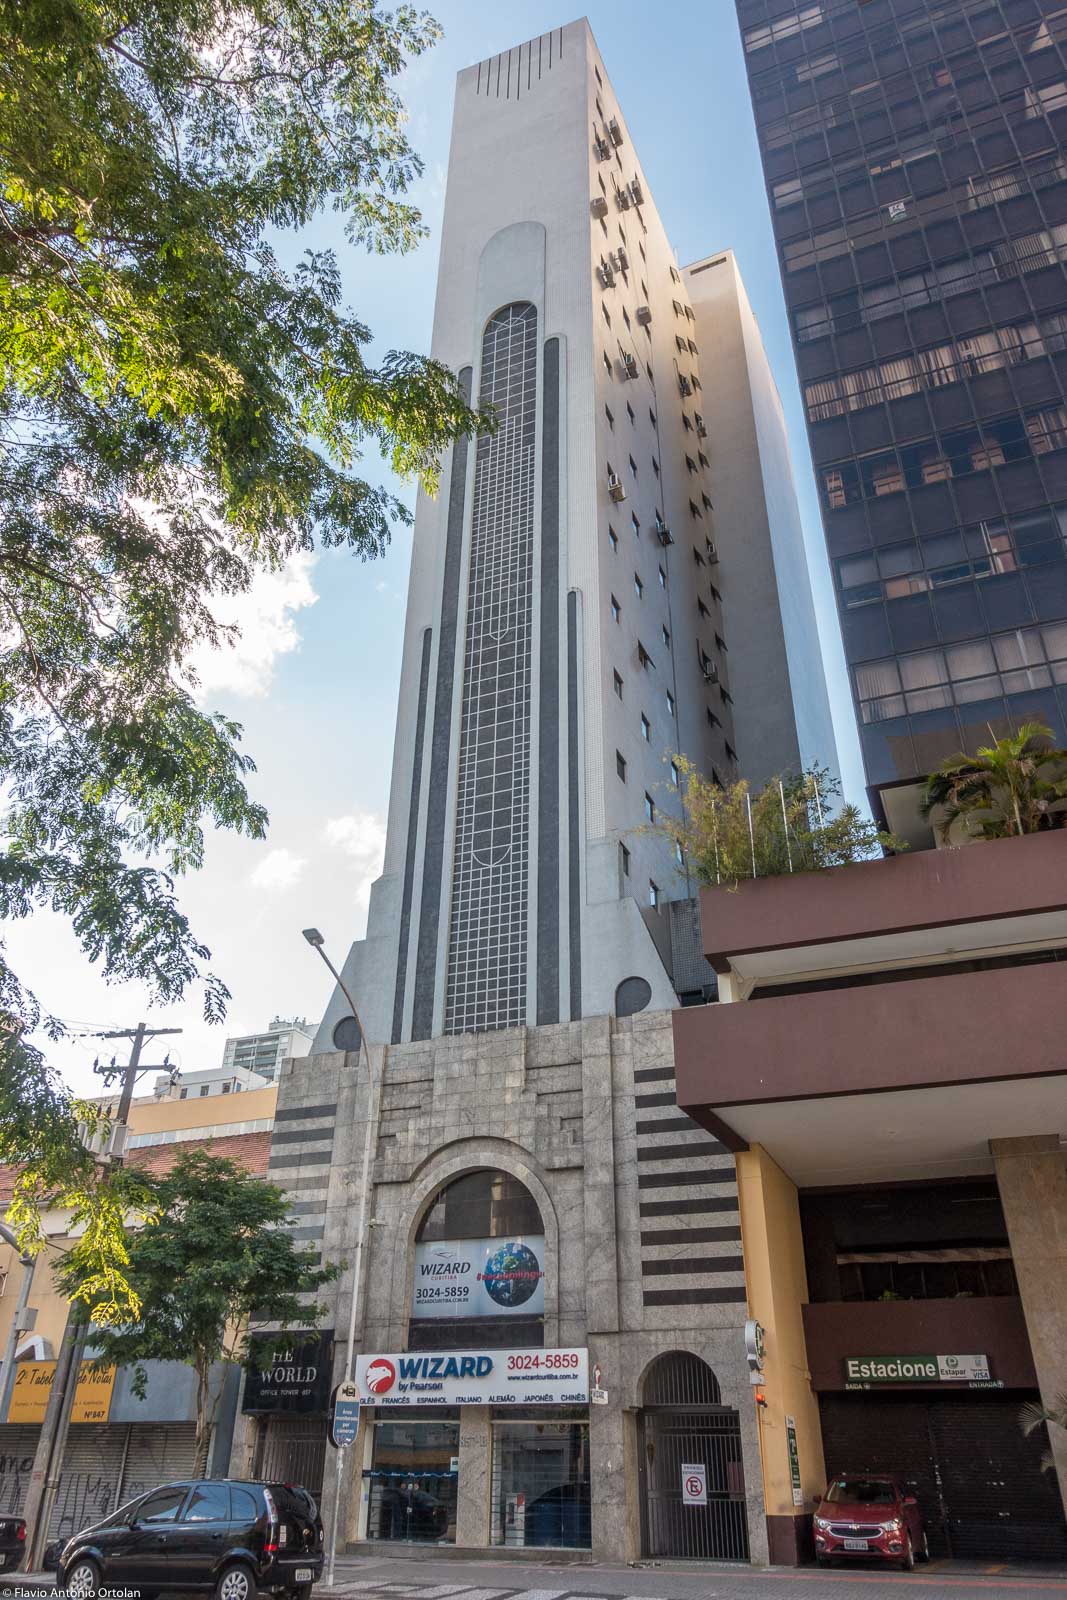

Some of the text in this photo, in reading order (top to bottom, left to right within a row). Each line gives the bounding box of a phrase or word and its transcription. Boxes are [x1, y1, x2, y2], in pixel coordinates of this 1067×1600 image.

[420, 1262, 471, 1276] WIZARD
[416, 1286, 470, 1299] 3024-5859
[398, 1353, 579, 1379] WIZARD 3024-5859
[847, 1358, 936, 1378] Estacione
[261, 1366, 317, 1383] WORLD
[973, 1371, 989, 1379] VISA
[398, 1381, 444, 1393] by Pearson
[417, 1396, 448, 1404] ESPANHOL
[455, 1396, 482, 1404] ITALIANO
[488, 1393, 516, 1403] ALEMÃO
